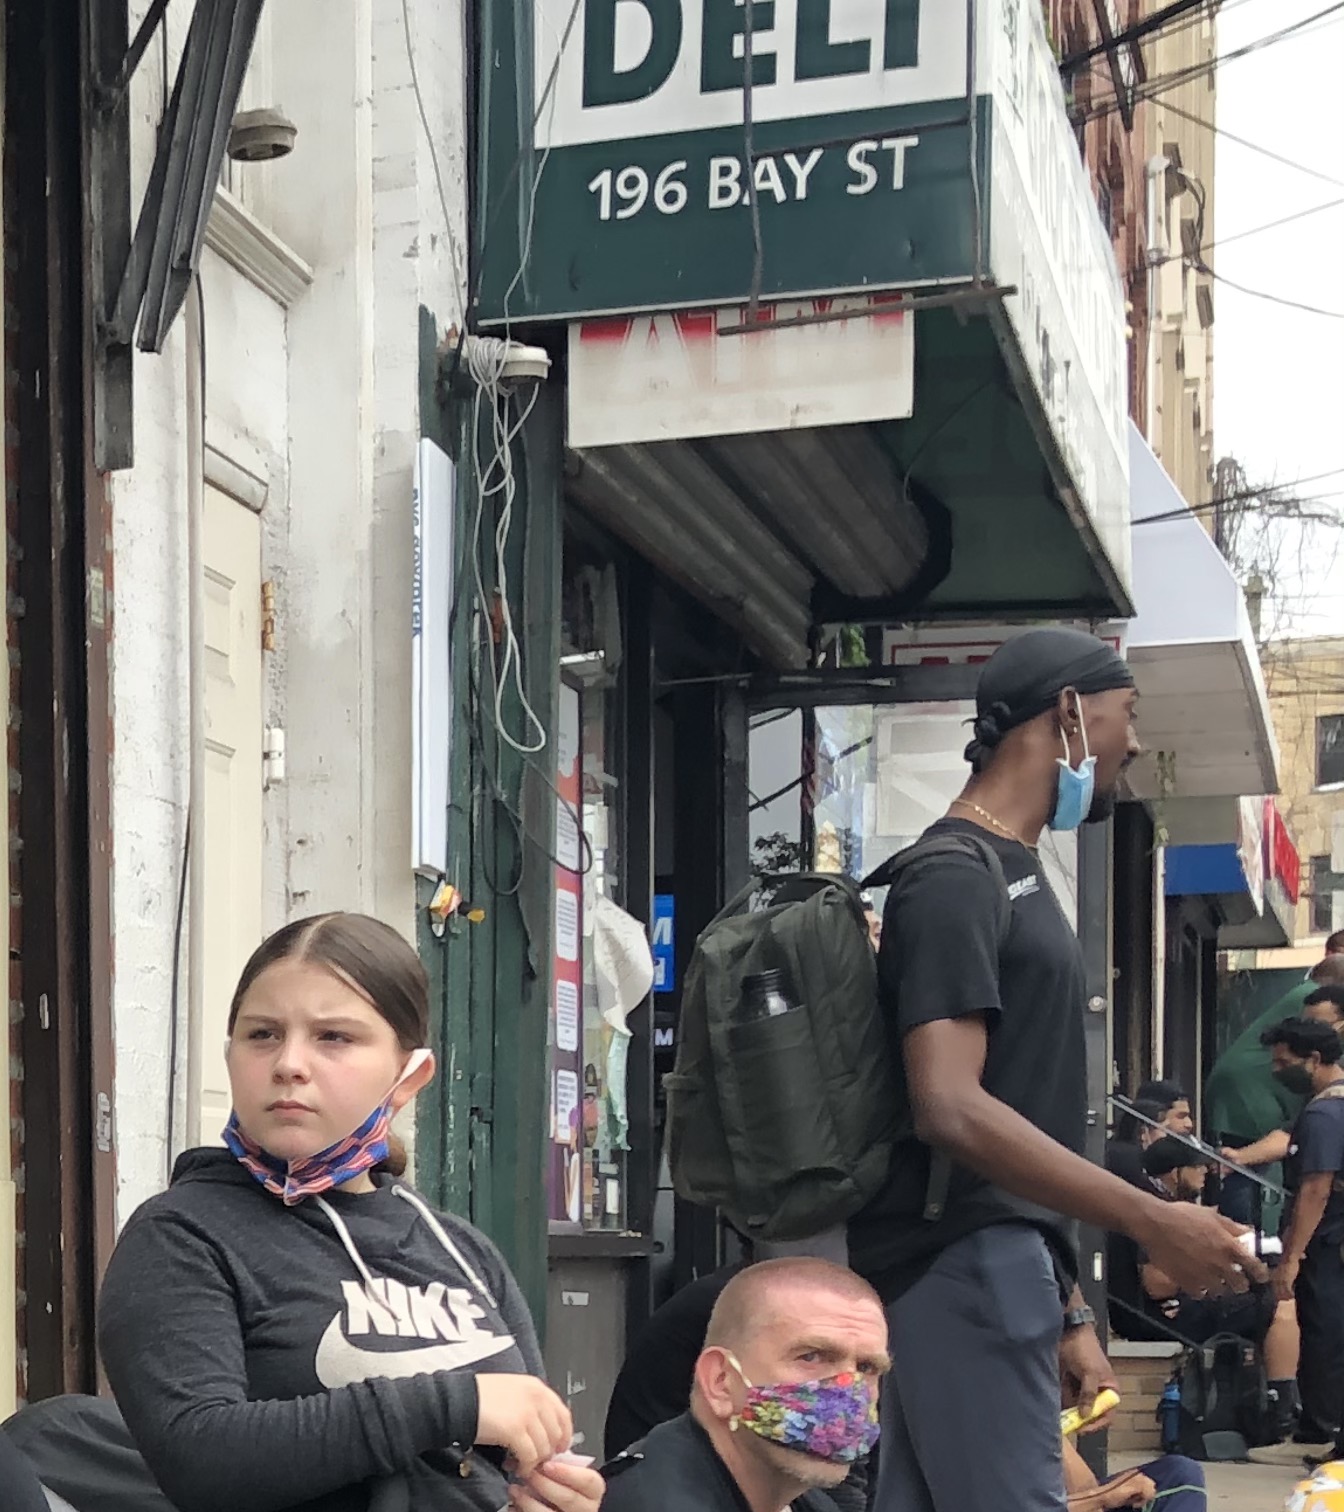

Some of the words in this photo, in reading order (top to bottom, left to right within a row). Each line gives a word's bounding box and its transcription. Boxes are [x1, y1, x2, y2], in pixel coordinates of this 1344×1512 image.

[581, 0, 919, 109] DELI
[588, 160, 688, 221] 196
[708, 148, 824, 210] BAY
[846, 135, 919, 195] ST
[340, 1277, 494, 1341] NIKE
